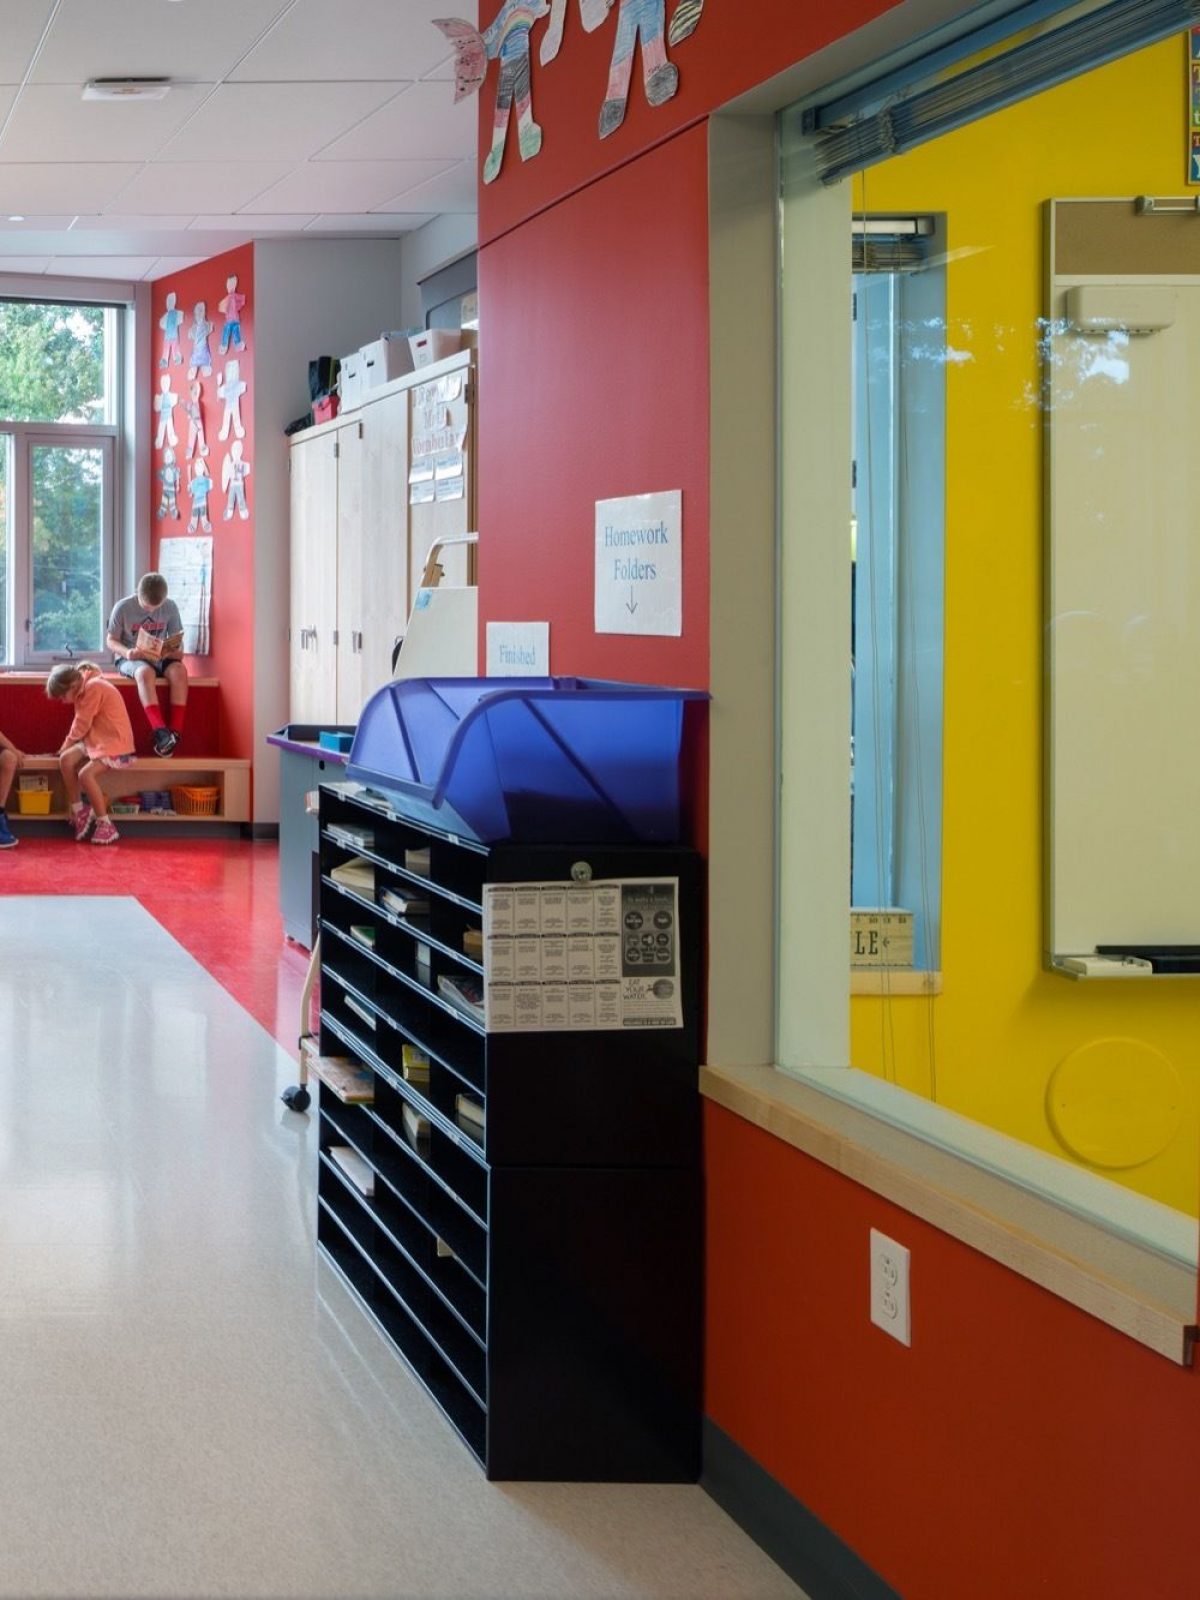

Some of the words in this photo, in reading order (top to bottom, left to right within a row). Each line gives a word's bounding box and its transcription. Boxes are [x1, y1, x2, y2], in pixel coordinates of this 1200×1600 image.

[604, 521, 669, 548] Homework
[613, 558, 657, 581] Folders
[498, 645, 536, 666] Finished
[854, 930, 878, 955] LE
